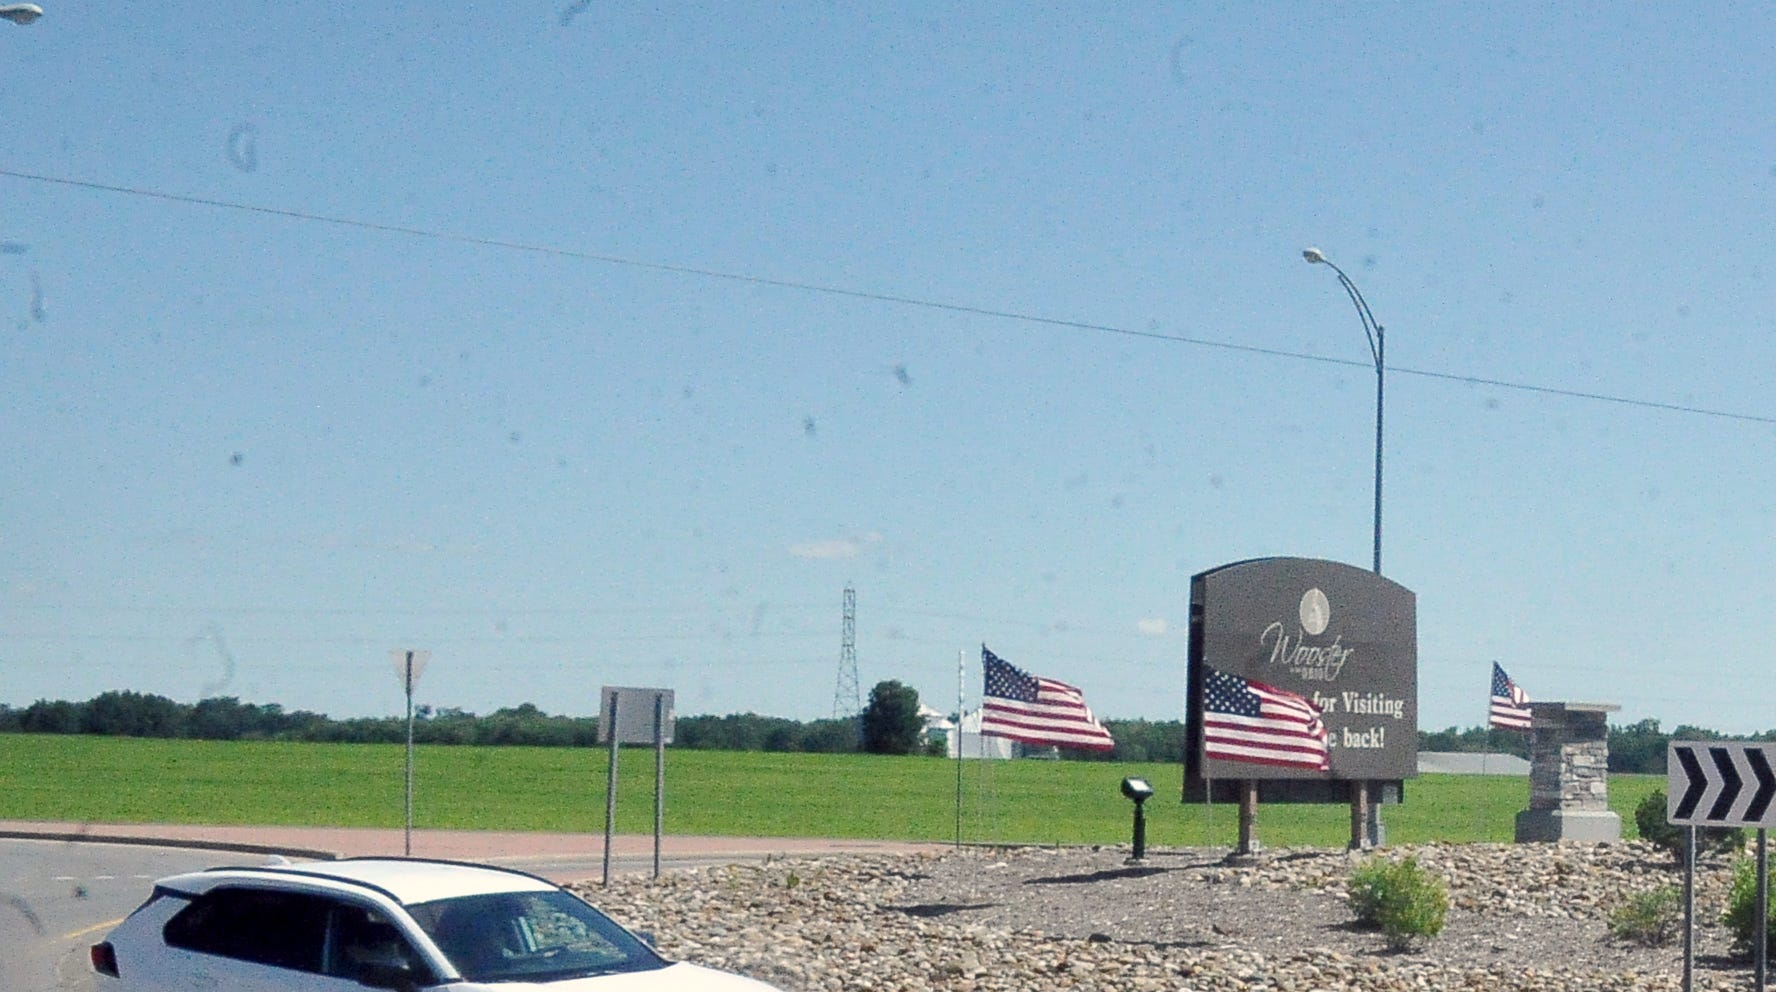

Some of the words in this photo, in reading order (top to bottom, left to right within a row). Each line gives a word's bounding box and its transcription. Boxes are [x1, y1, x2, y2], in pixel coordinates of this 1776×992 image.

[1260, 621, 1355, 681] Wooster
[1342, 691, 1404, 719] Visiting
[1343, 726, 1385, 748] back!
